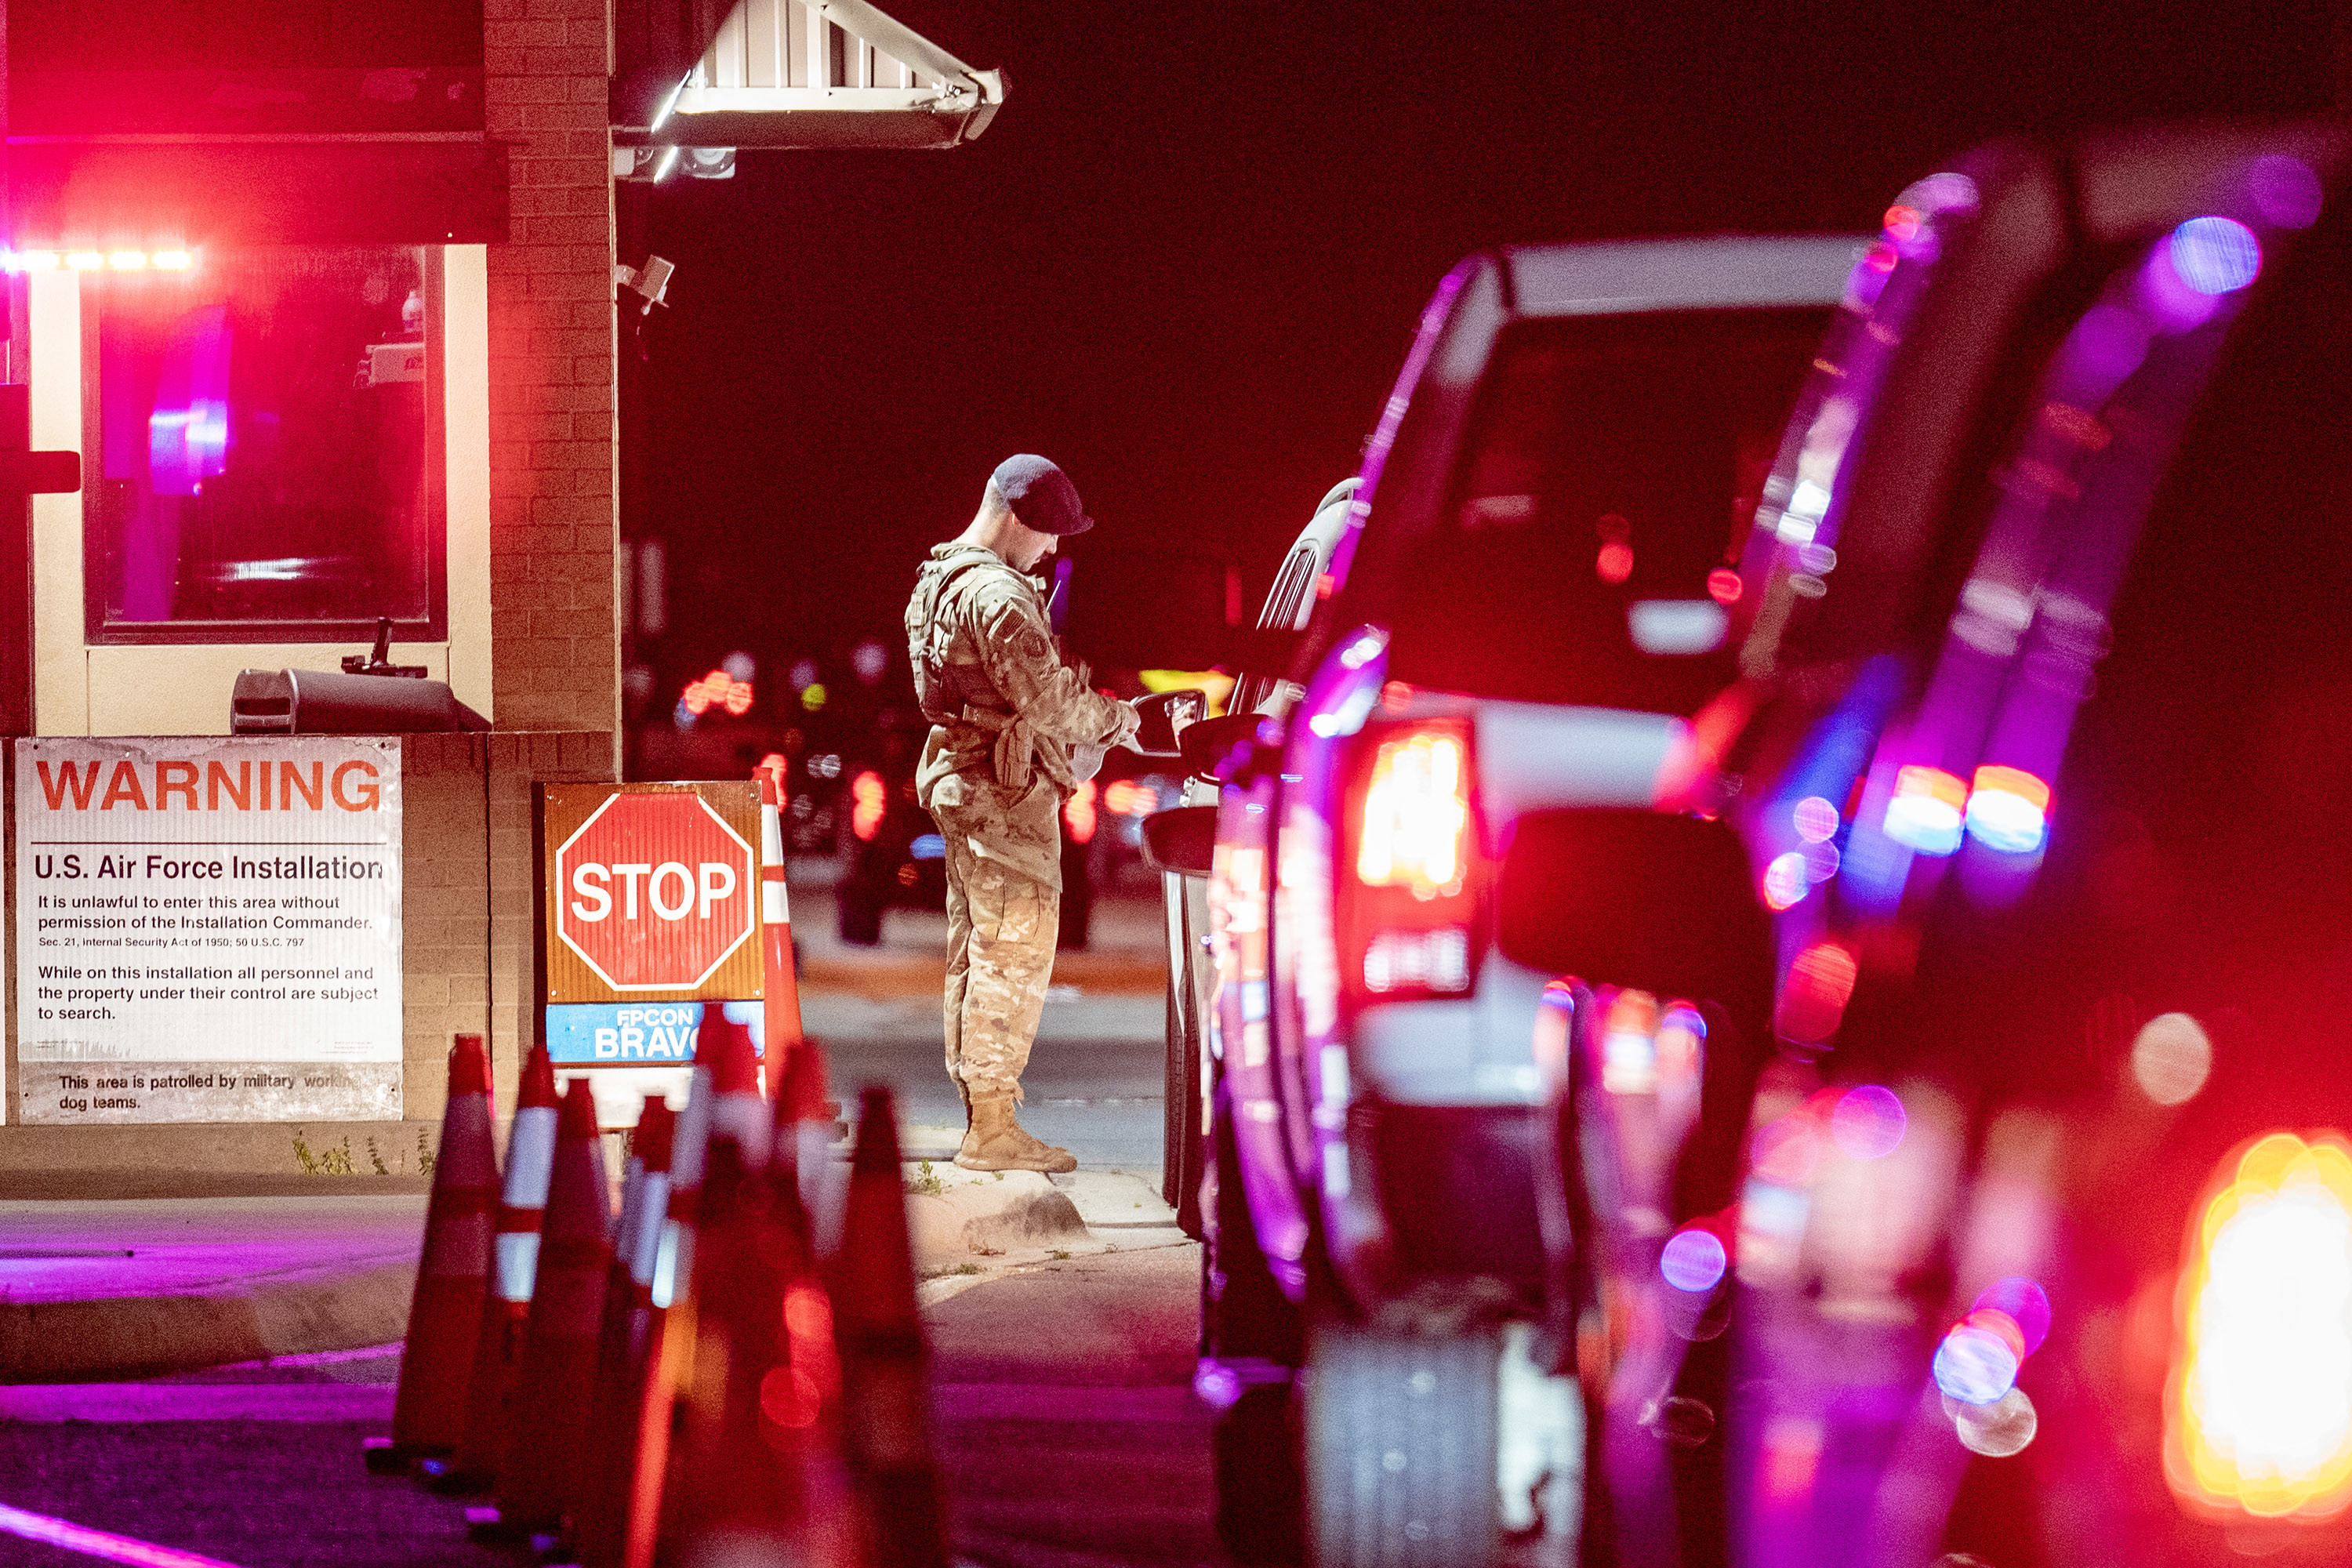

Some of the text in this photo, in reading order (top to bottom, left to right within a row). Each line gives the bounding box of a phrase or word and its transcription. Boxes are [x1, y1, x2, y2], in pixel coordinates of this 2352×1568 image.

[35, 760, 380, 812] WARNING
[34, 854, 383, 880] U.S. Air Force Installation
[571, 861, 736, 922] STOP
[38, 895, 339, 909] It is unlawful to enter this area without
[38, 915, 372, 931] permission of the Installation Commander.
[39, 937, 305, 949] Sec. 21, Internal Security Act of 1950; 50 U.S.C. 797
[38, 966, 374, 982] While on this installation all personnel and
[38, 986, 378, 1003] the property under their control are subject
[38, 1007, 116, 1020] to search.
[616, 1008, 693, 1027] FPCON
[59, 1075, 89, 1089] This
[96, 1077, 128, 1089] area
[132, 1075, 145, 1089] is
[150, 1075, 214, 1091] patrolled
[220, 1074, 236, 1091] by
[244, 1074, 295, 1090] military
[59, 1095, 141, 1112] dog teams.
